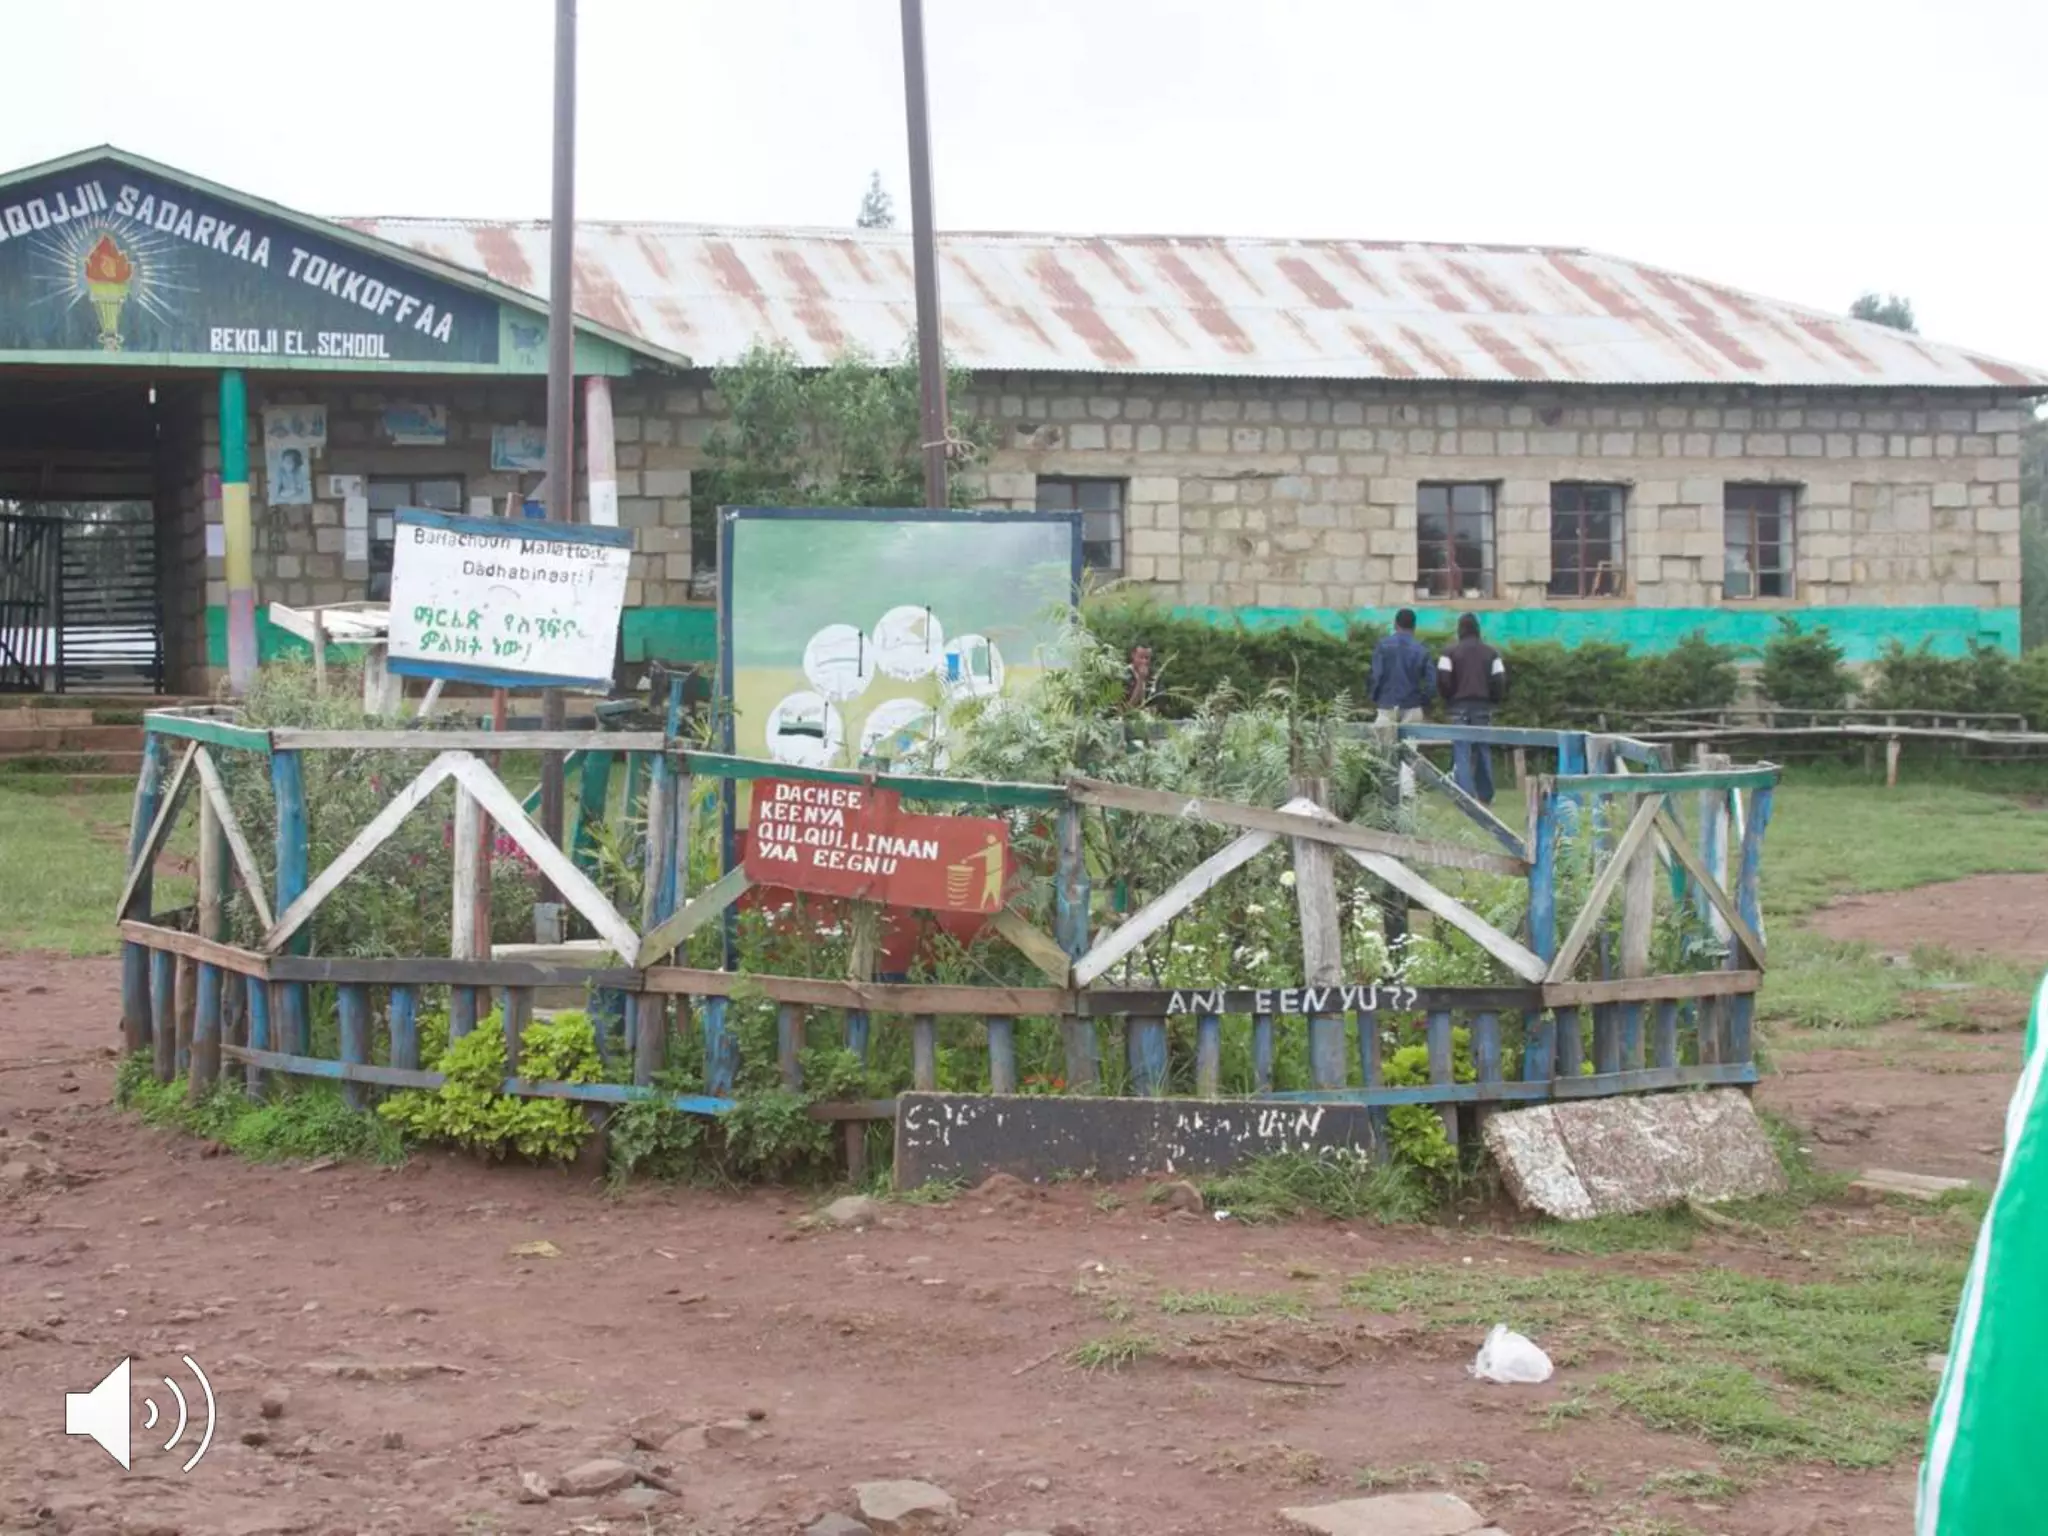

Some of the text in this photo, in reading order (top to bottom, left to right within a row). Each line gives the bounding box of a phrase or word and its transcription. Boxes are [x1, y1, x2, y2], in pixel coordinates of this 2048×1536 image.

[115, 184, 270, 267] SADARKAA
[288, 247, 454, 343] TOKKOFFAA
[210, 328, 278, 352] BEKOJI
[775, 784, 862, 809] DACHEE
[760, 801, 844, 828] KEENYA
[758, 823, 938, 860] QULQULLINAAN
[758, 842, 898, 876] YAA EEGNU
[1166, 989, 1226, 1015] ANI
